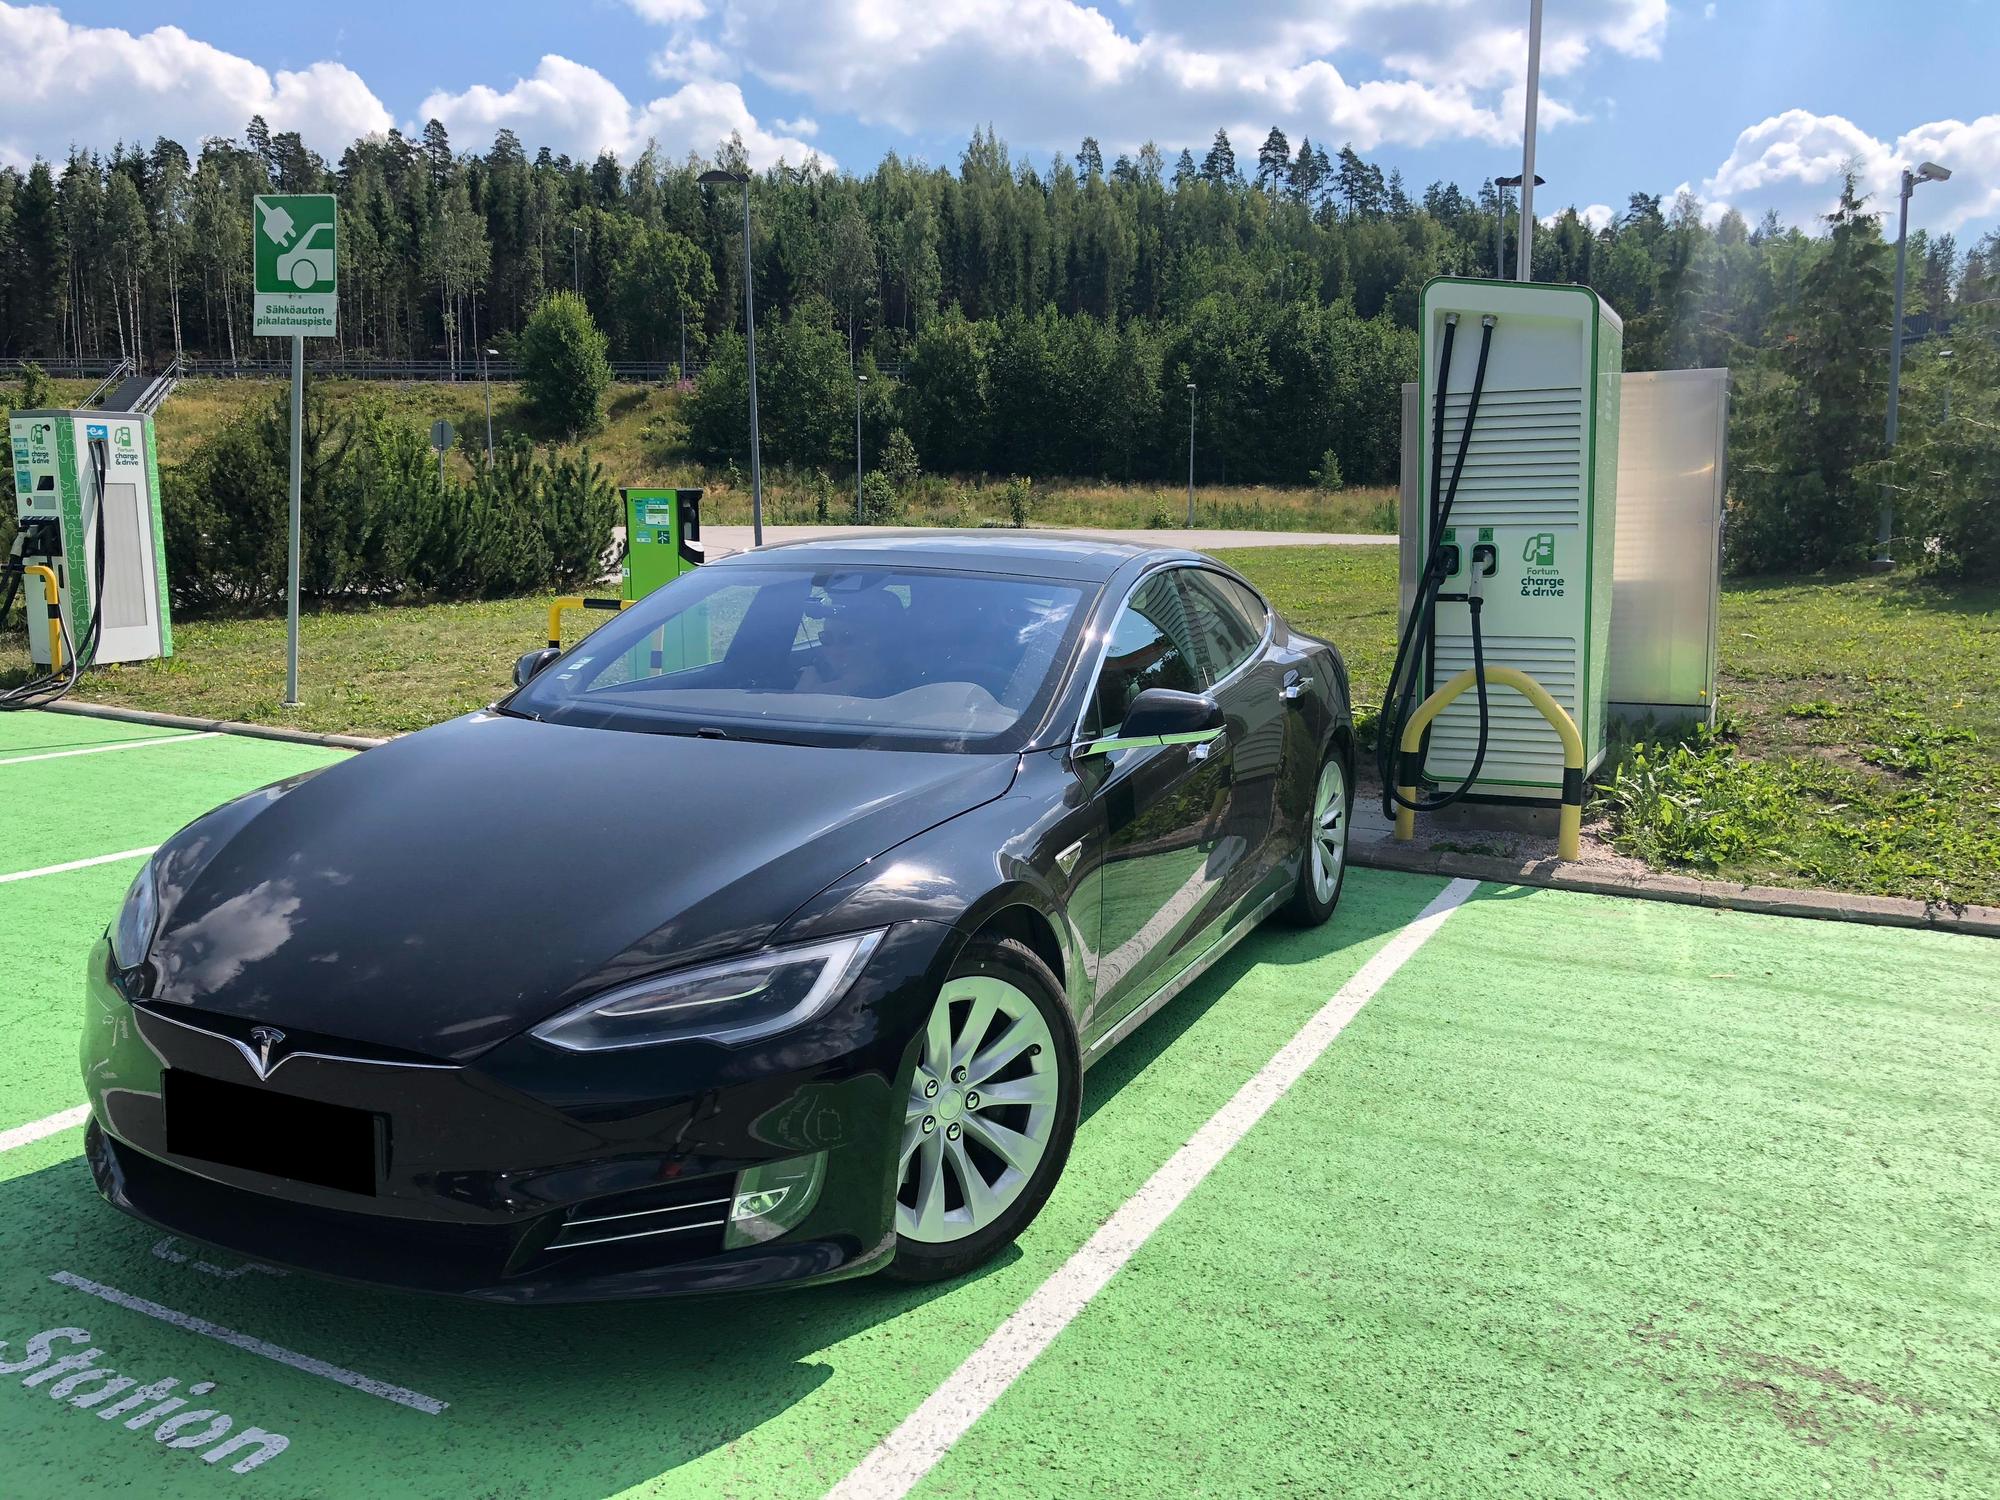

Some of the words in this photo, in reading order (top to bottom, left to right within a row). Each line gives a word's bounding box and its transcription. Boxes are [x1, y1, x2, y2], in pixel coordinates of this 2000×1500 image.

[266, 305, 324, 314] Sähköauton
[257, 316, 332, 326] pikalatauspiste
[115, 452, 138, 460] charge
[1445, 531, 1453, 539] B
[1482, 531, 1490, 539] A
[1527, 567, 1559, 575] Fortum
[1521, 576, 1564, 588] charge
[1521, 587, 1531, 596] &
[1533, 587, 1564, 596] drive
[0, 1326, 291, 1474] Station
